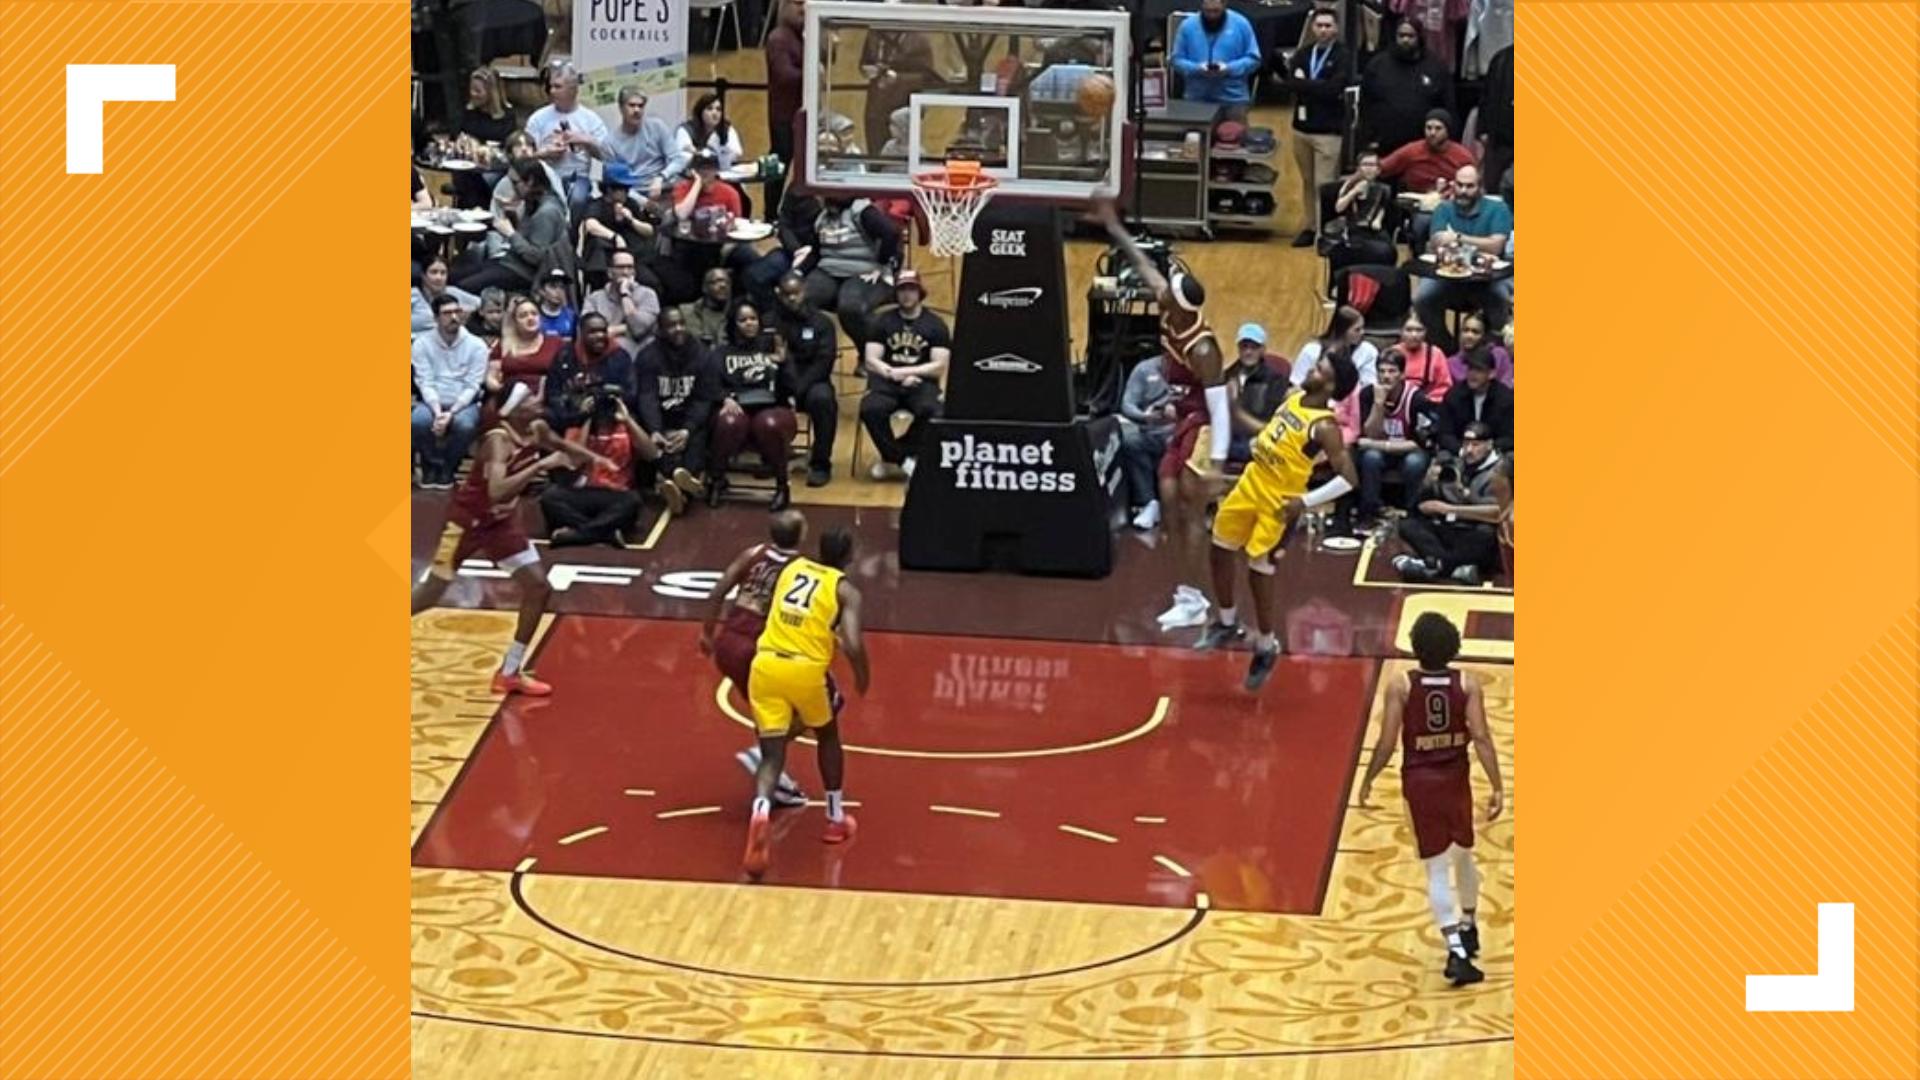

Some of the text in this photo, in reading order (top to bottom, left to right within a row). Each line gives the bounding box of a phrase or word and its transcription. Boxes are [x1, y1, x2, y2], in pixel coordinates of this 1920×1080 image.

[591, 0, 669, 23] POPES
[591, 28, 670, 42] COCKTAILS
[991, 229, 1026, 243] SEAT
[989, 243, 1027, 257] GEEK
[940, 434, 1054, 468] planet
[955, 461, 1076, 492] fitness
[784, 573, 820, 608] 21
[1425, 690, 1450, 732] 9
